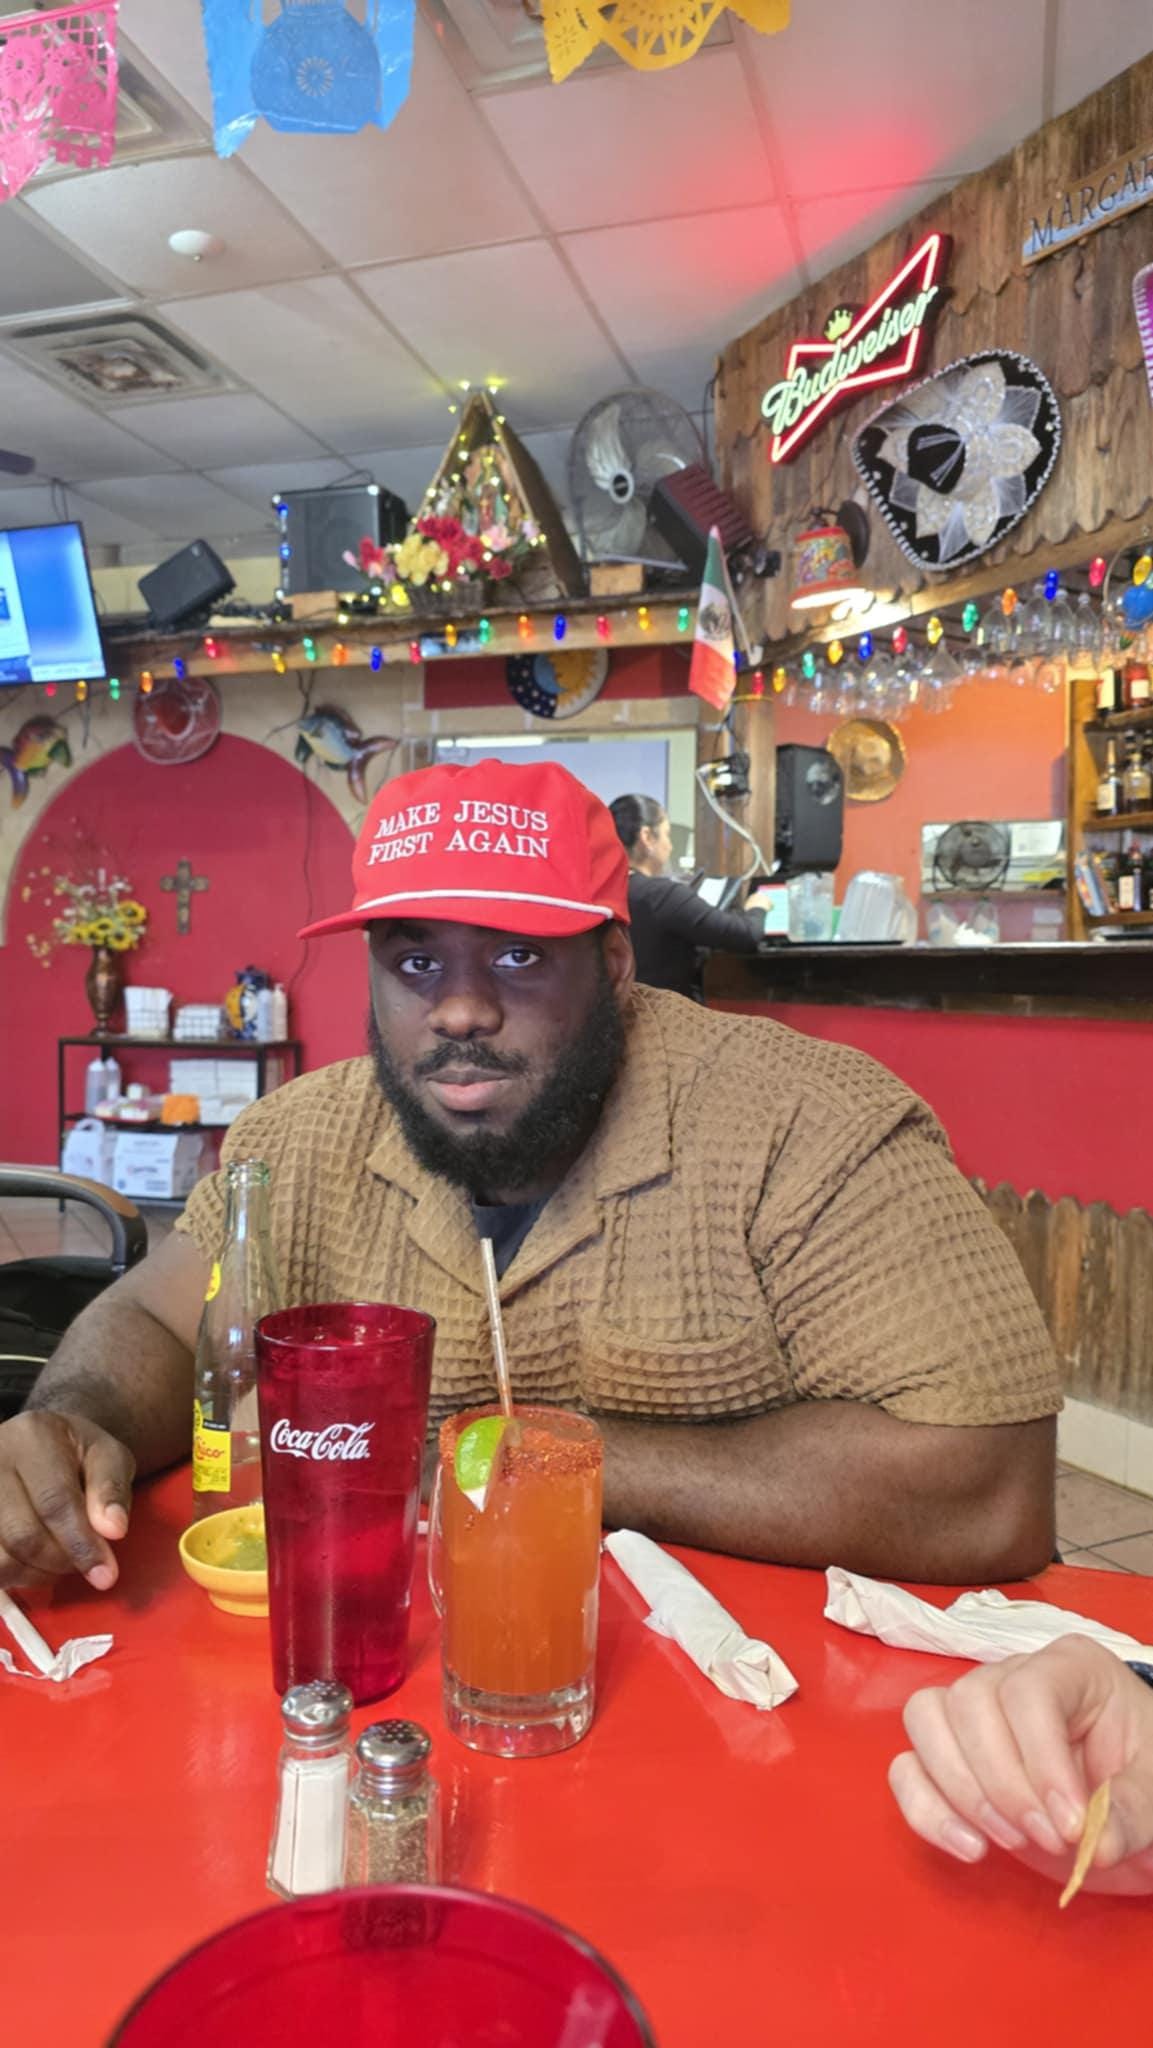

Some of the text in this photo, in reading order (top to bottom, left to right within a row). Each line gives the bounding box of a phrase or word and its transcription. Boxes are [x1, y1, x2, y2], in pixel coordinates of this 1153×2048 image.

[761, 285, 939, 436] Budweiser
[374, 799, 549, 839] MAKE JESUS
[367, 829, 549, 866] FIRST AGAIN
[270, 1418, 376, 1460] Coca-Cola
